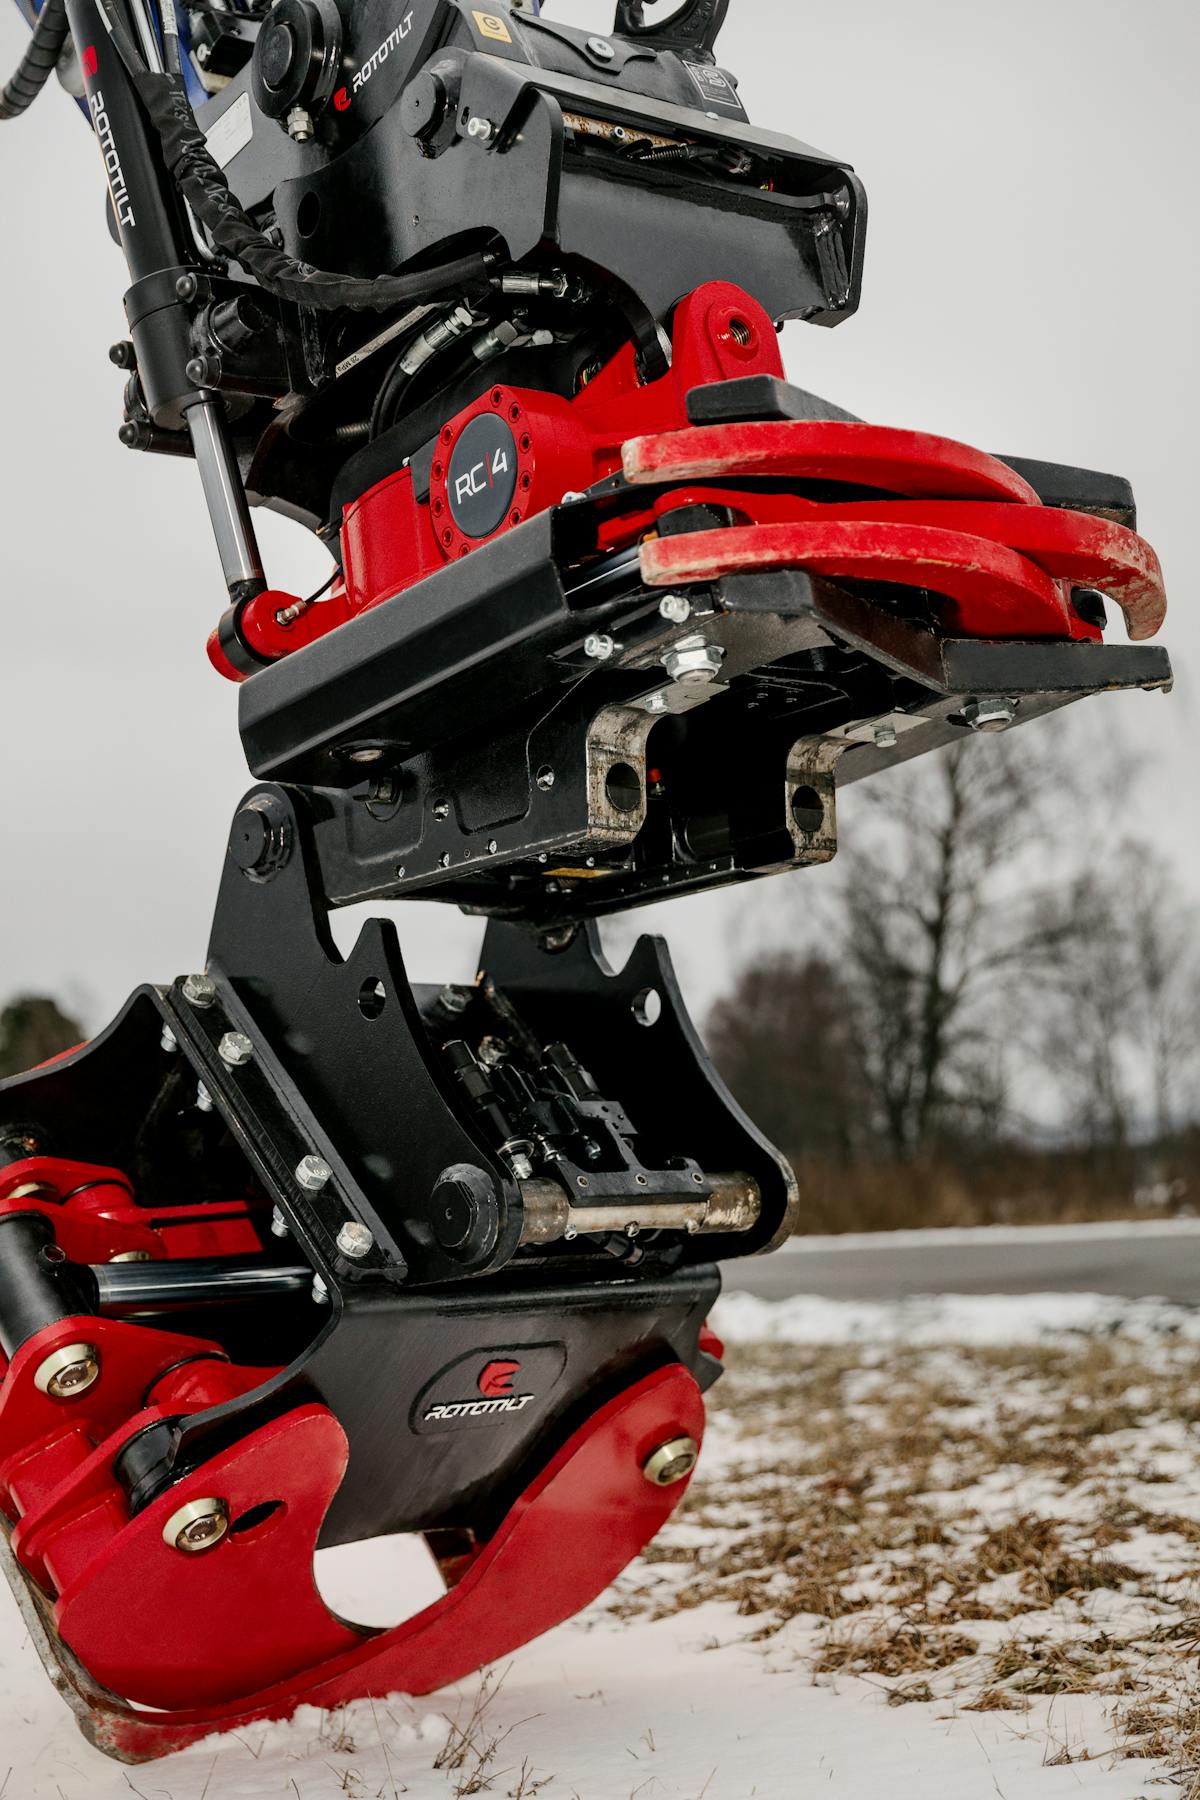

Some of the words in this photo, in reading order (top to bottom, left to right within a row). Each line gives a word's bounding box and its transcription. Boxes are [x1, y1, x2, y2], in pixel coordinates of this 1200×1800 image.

[352, 10, 414, 93] ROTOTILT
[91, 91, 136, 227] ROTOTILT
[424, 1395, 535, 1420] ROTOTILT
